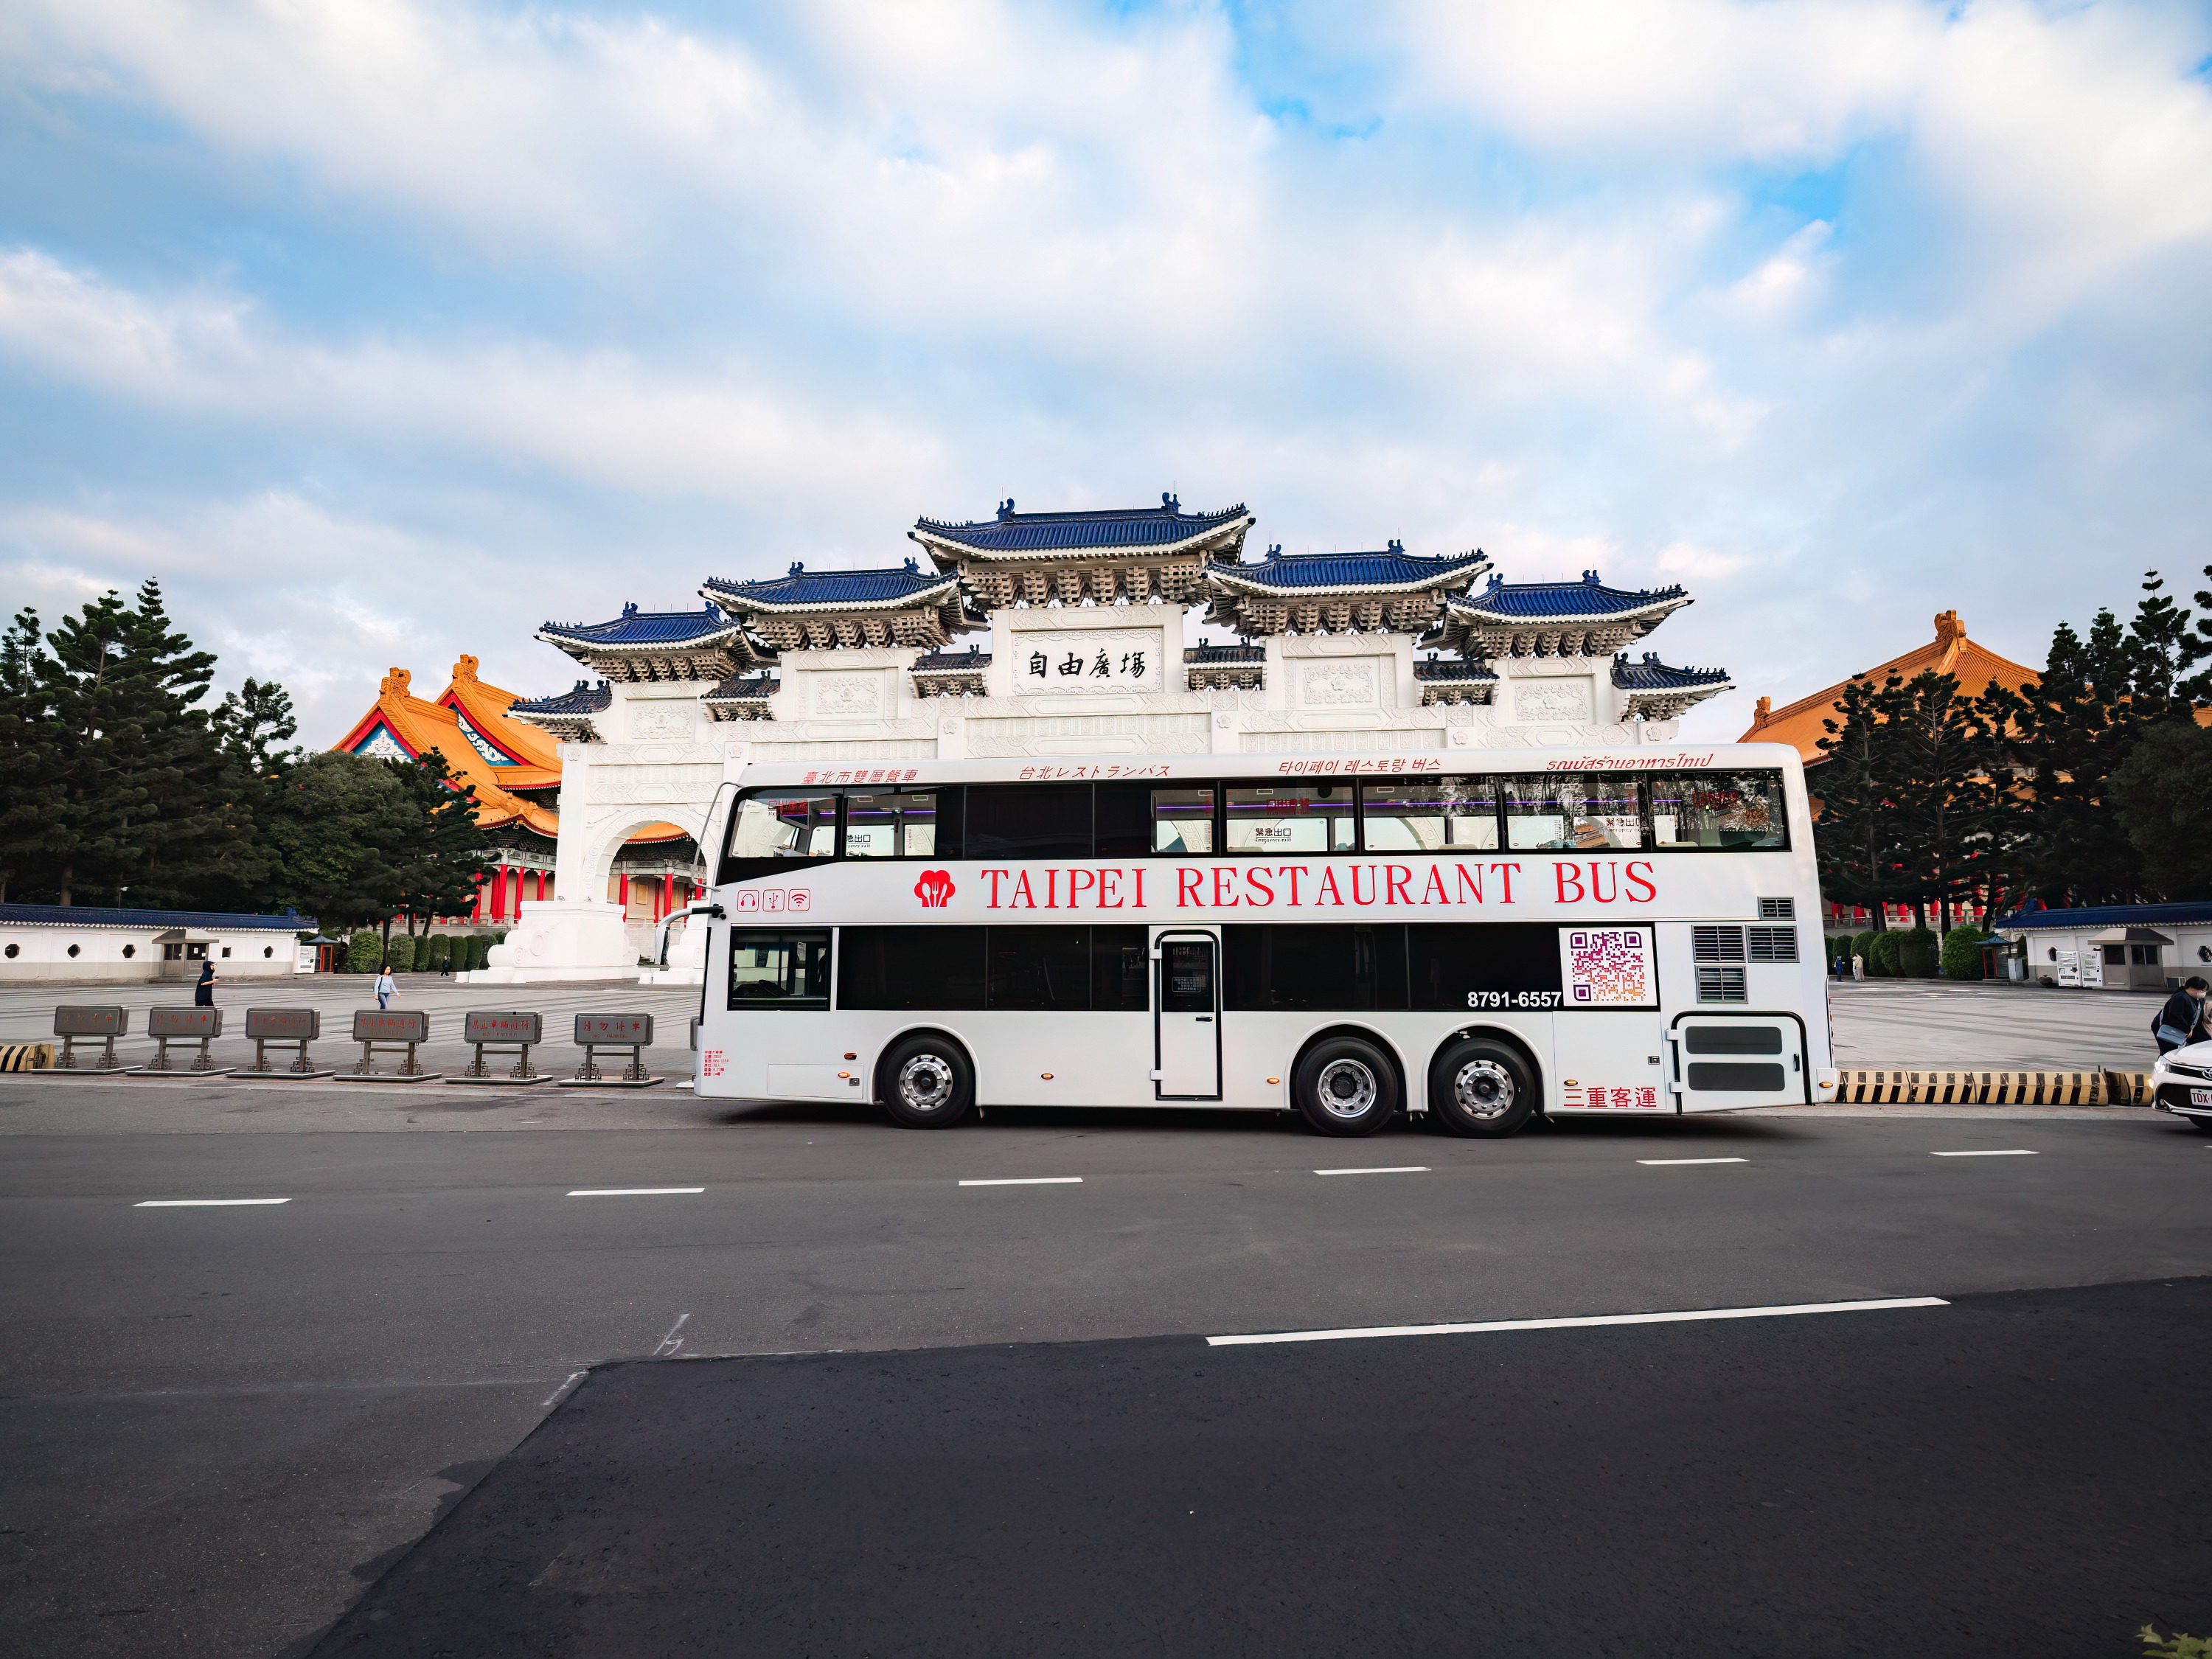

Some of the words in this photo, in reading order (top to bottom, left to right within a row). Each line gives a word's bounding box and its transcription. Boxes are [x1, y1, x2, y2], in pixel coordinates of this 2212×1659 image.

[1019, 765, 1170, 780] 台北レストランバス
[1279, 759, 1340, 775] 타이페이
[1344, 759, 1406, 774] 레스토랑
[1412, 758, 1441, 773] 버스
[801, 769, 919, 785] 臺北市雙層餐車
[1255, 827, 1292, 837] 緊急出口
[981, 868, 1148, 909] TAIPEI
[1175, 863, 1521, 908] RESTAURANT
[1554, 860, 1657, 904] BUS
[1467, 991, 1562, 1008] 8791-6557
[1563, 1086, 1657, 1107] 三重客運
[2191, 1093, 2212, 1104] TDX-
